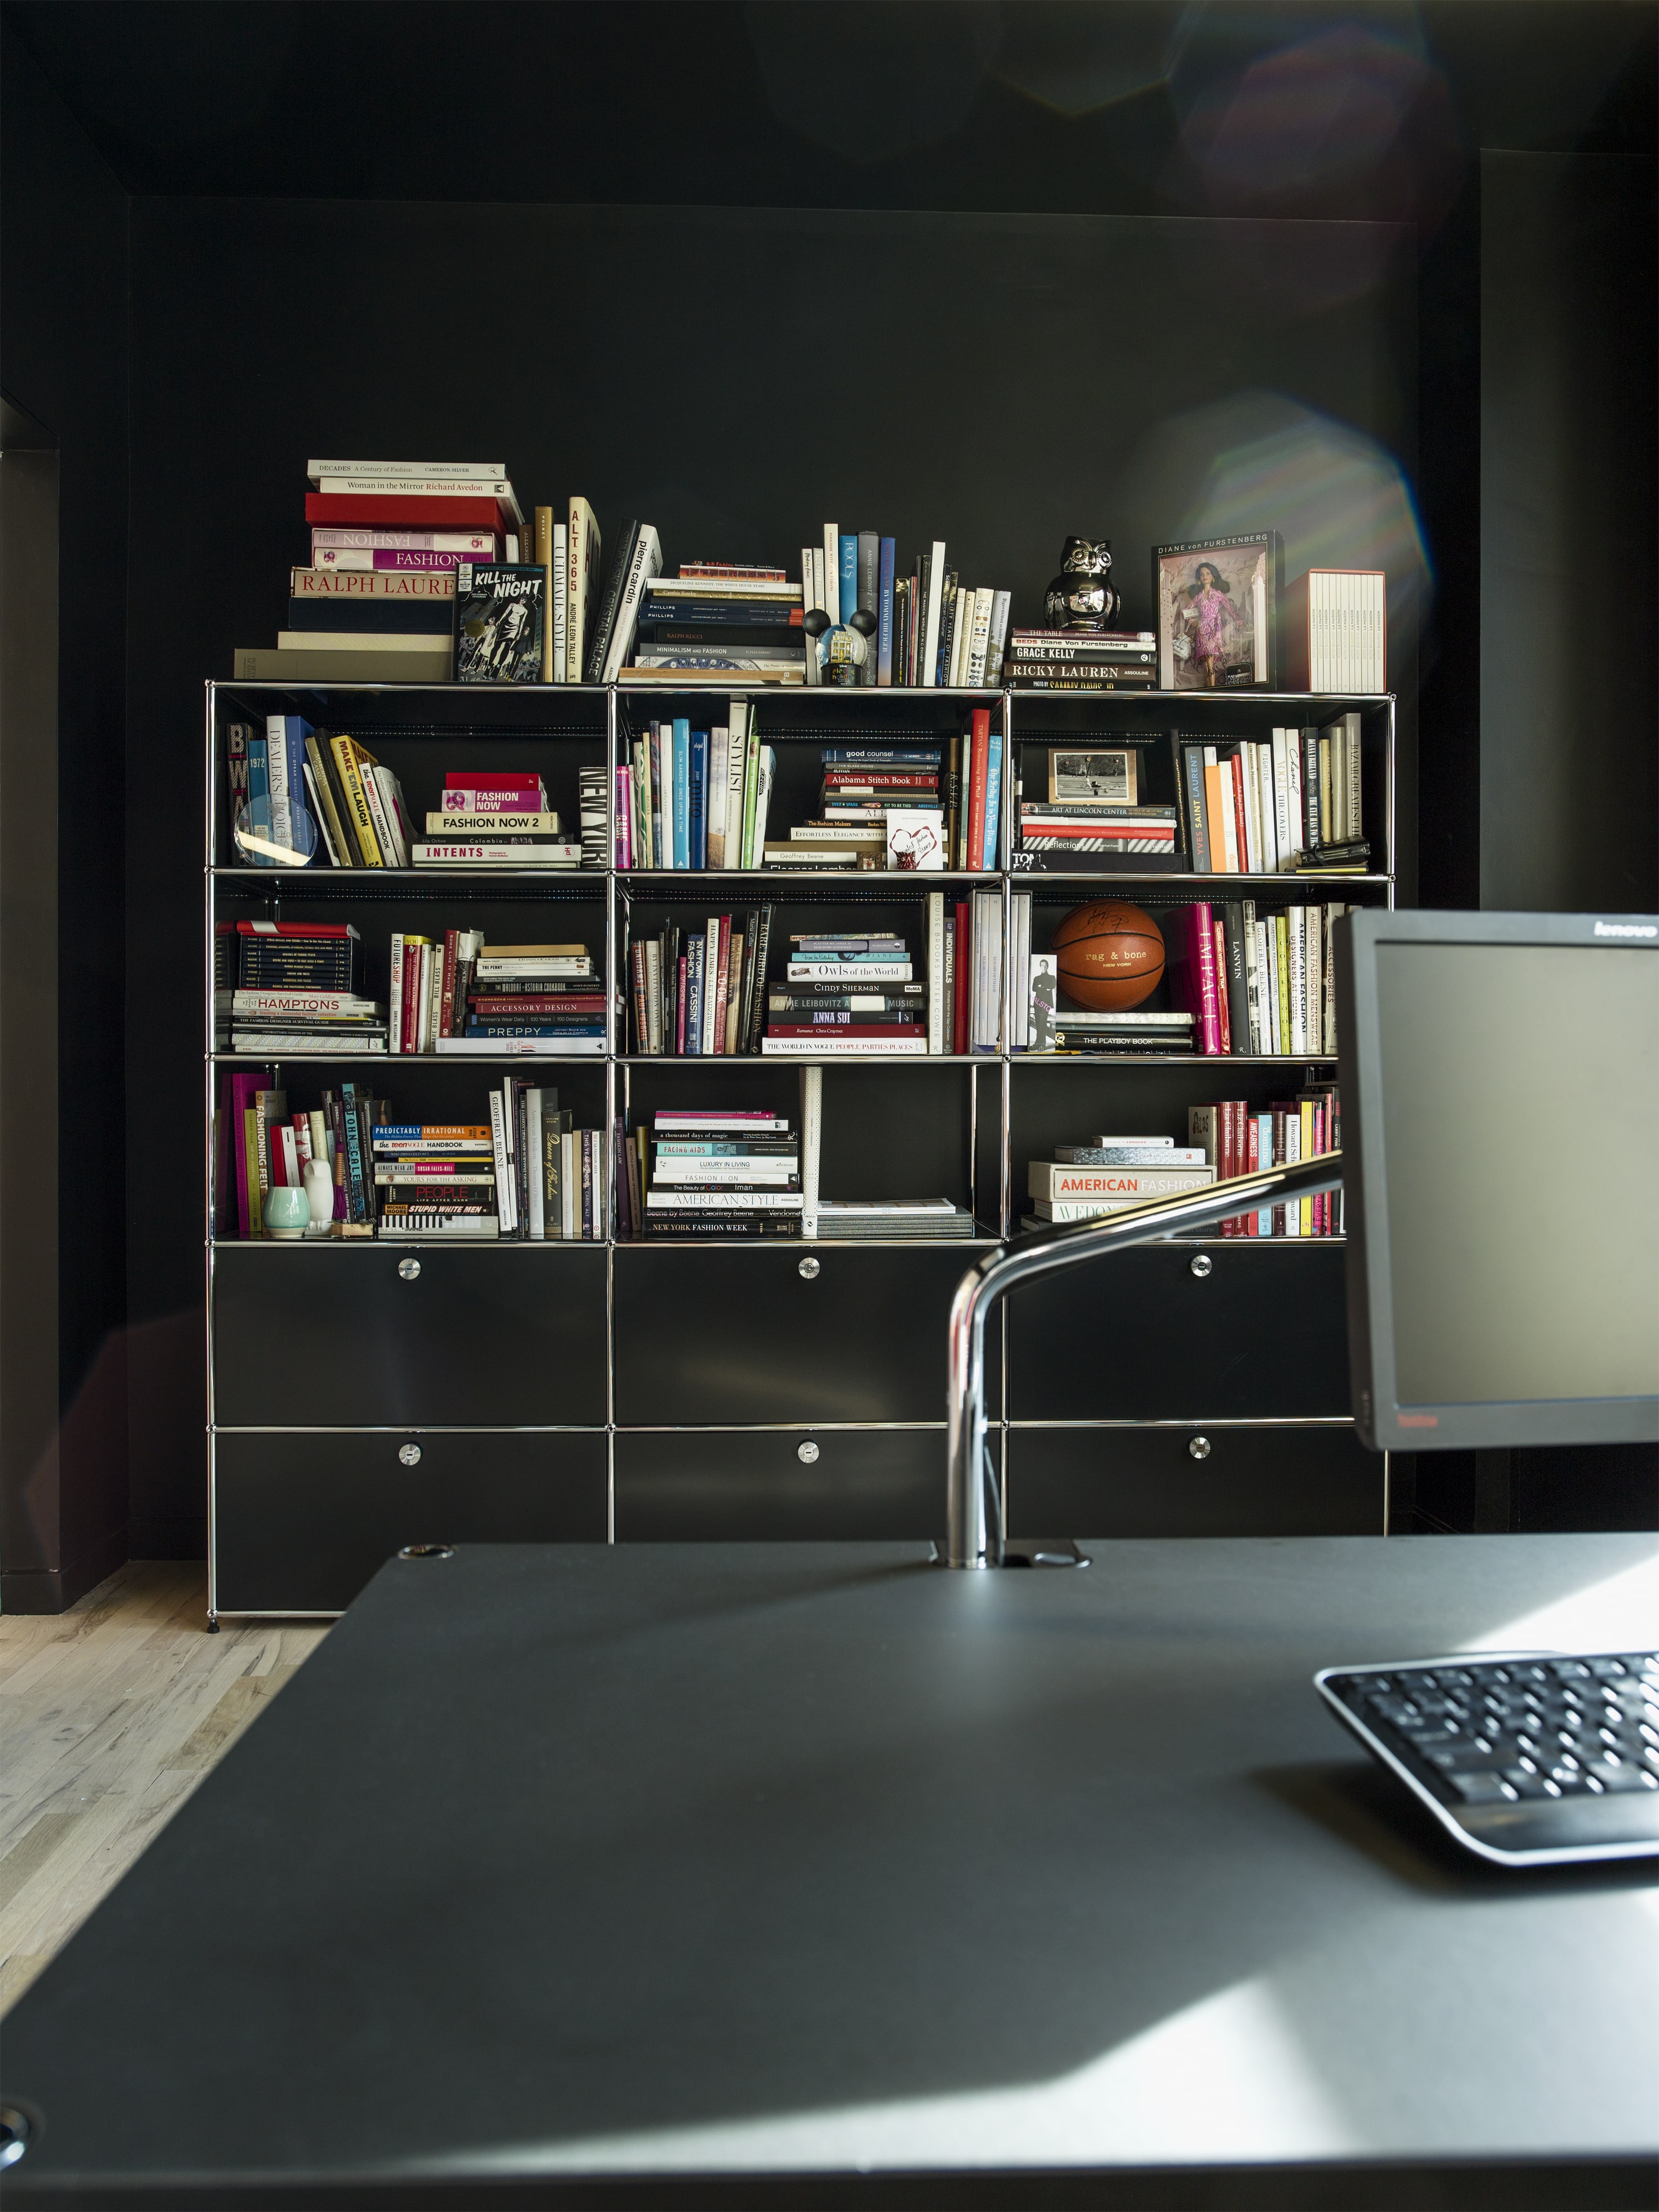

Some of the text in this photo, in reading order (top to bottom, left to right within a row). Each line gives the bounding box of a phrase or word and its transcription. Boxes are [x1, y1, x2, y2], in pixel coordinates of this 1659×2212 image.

[343, 534, 410, 546] FASHION
[1159, 544, 1185, 554] DIANE
[1204, 534, 1268, 548] FURSTENBERG
[396, 554, 464, 566] FASHION
[845, 543, 854, 579] POOLS
[626, 540, 648, 604] pierre cardin
[475, 571, 501, 586] KILL
[302, 576, 455, 594] RALPH LAURE
[494, 579, 543, 598] NIGHT
[1017, 648, 1075, 659] GRACE KELLY
[1012, 666, 1055, 676] RICKY
[1061, 667, 1118, 677] LAUREN
[250, 759, 265, 768] 1972
[1190, 755, 1199, 797] LAURENT
[477, 793, 518, 801] FASHION
[477, 802, 501, 810] NOW
[1193, 800, 1202, 828] SAINT
[443, 818, 539, 827] FASHION NOW 2
[426, 848, 483, 857] INTENTS
[1085, 953, 1105, 961] rag
[1124, 951, 1146, 959] bone
[1233, 941, 1241, 979] LANVIN
[819, 965, 898, 976] Owls of the World
[258, 999, 339, 1010] HAMPTONS
[689, 986, 697, 1023] CASSINI
[813, 1013, 850, 1023] ANNA SUI
[1061, 1179, 1206, 1191] AMERICAN FASHION
[416, 1187, 468, 1198] PEOPLE
[673, 1195, 739, 1205] AMERICAN
[742, 1196, 778, 1205] STYLE
